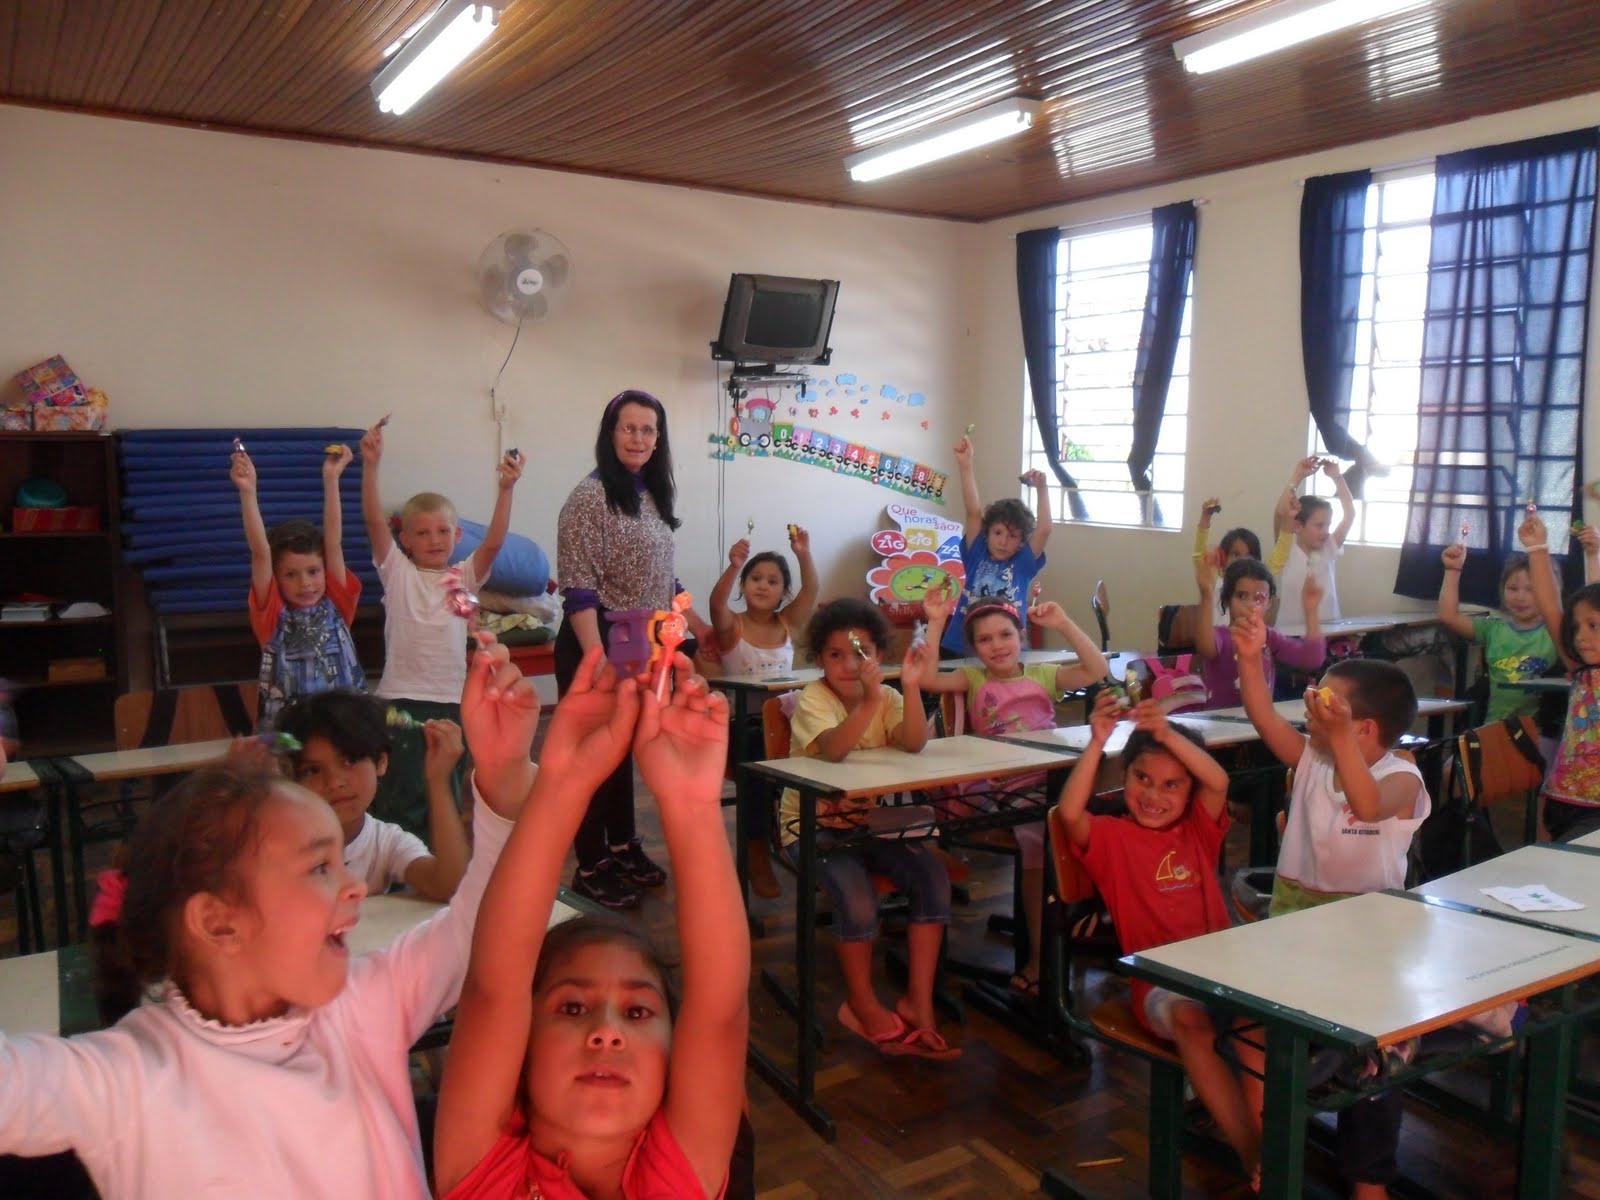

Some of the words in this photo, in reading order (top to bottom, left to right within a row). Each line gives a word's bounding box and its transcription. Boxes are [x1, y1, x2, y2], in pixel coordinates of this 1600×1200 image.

[780, 428, 788, 439] 0
[815, 437, 824, 449] 2
[833, 443, 842, 454] 3
[851, 449, 859, 460] 4
[867, 454, 875, 465] 5
[884, 459, 892, 470] 6
[902, 464, 910, 475] 7
[917, 471, 925, 482] 8
[891, 504, 917, 516] Que
[904, 514, 938, 525] horas
